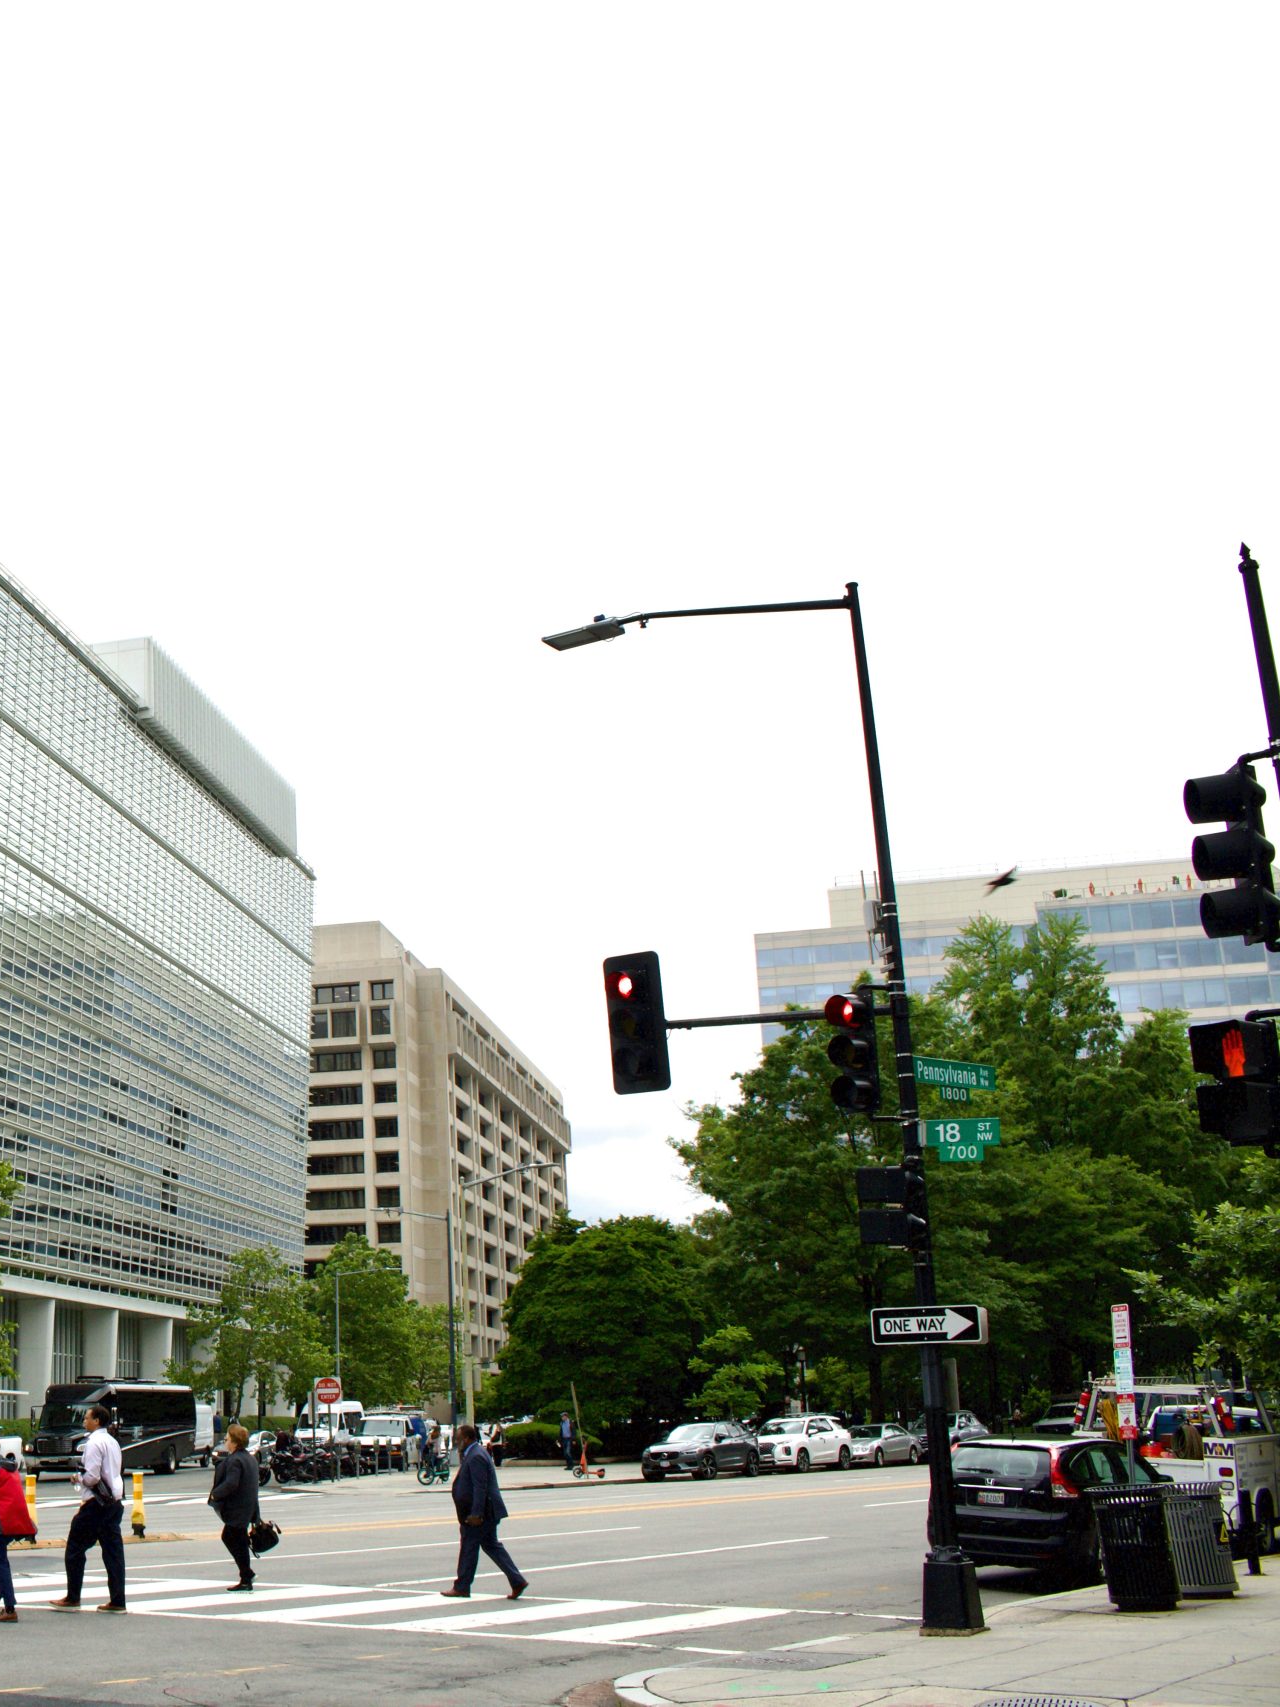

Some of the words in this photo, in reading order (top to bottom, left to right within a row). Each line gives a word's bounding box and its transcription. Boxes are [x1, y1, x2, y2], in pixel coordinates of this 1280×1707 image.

[917, 1061, 977, 1085] Pennsylvania
[980, 1067, 989, 1077] Ave
[942, 1087, 967, 1101] 1800
[935, 1123, 960, 1143] 18
[978, 1122, 991, 1131] ST
[977, 1132, 993, 1141] NW
[947, 1145, 977, 1159] 700
[883, 1319, 912, 1333] ONE
[916, 1318, 945, 1331] WAY
